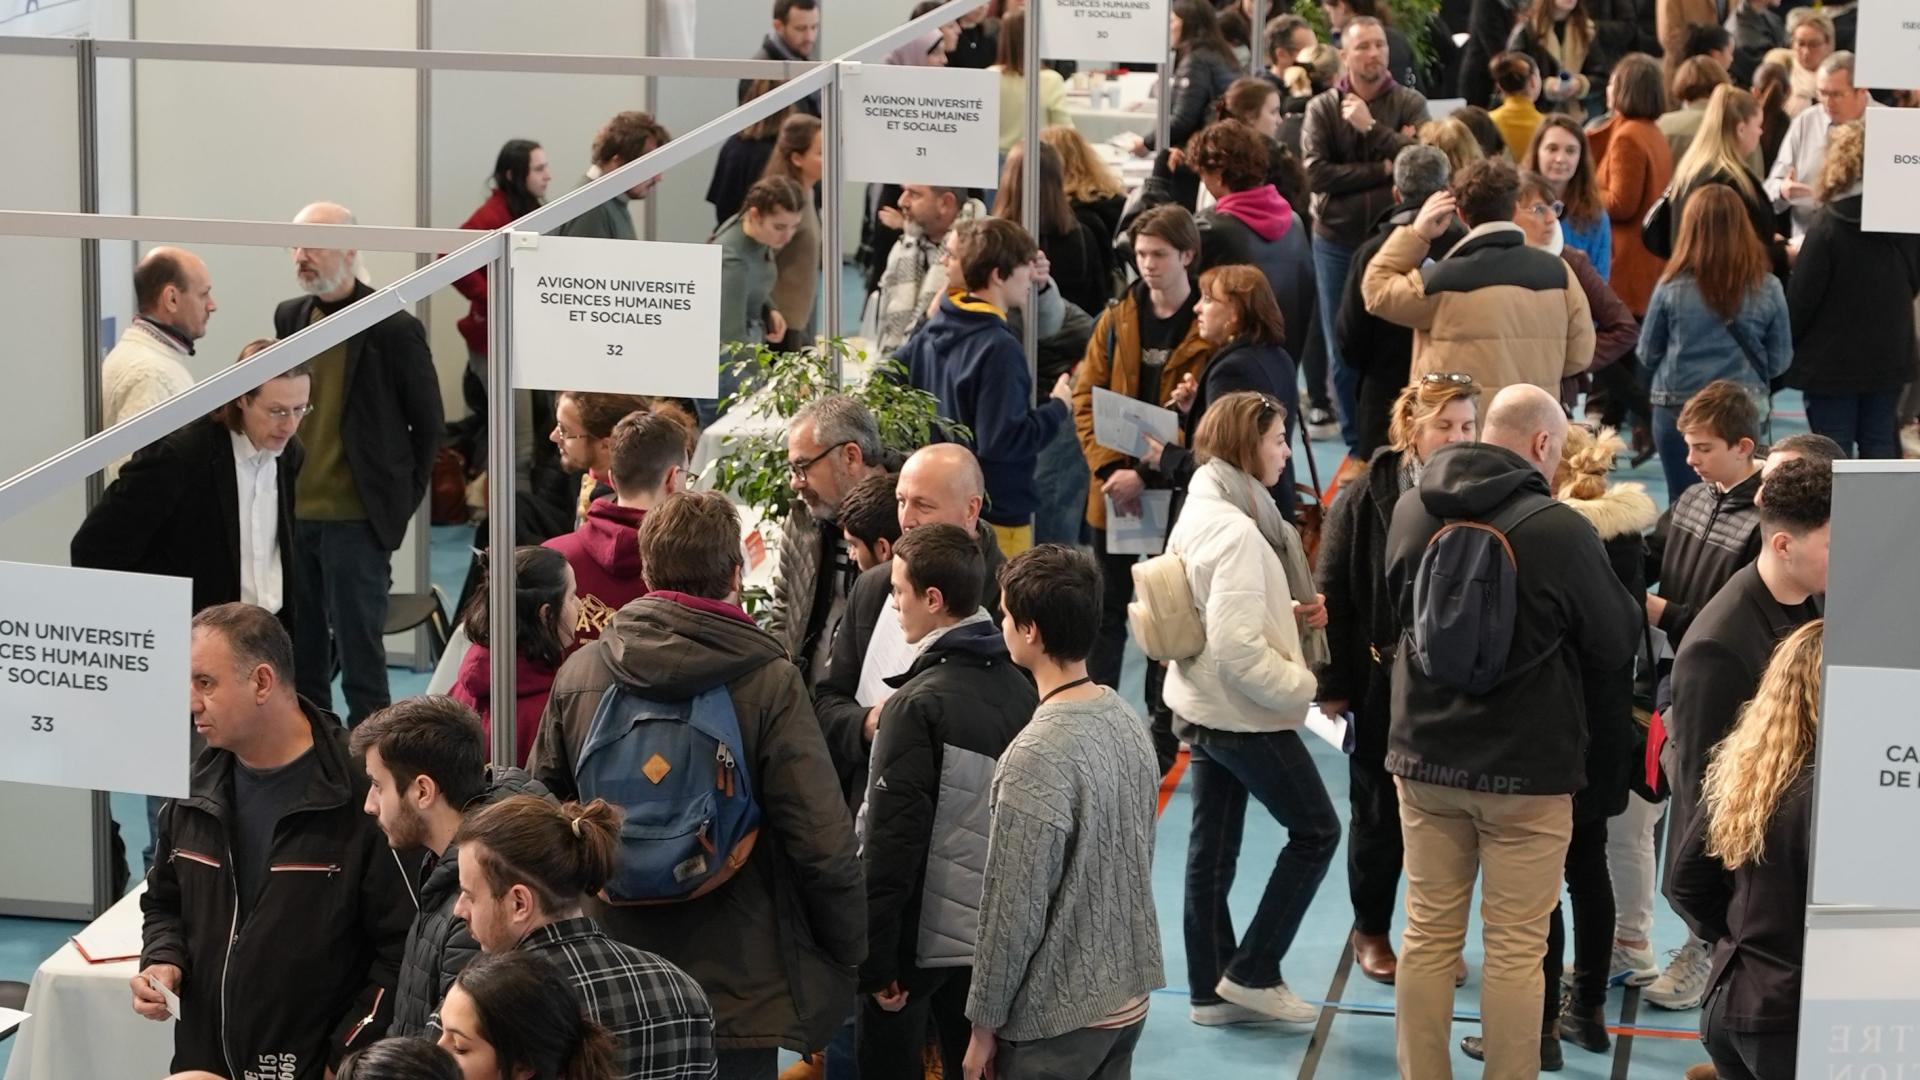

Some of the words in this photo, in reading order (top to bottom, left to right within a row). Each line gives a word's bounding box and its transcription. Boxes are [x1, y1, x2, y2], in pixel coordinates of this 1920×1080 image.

[1057, 0, 1100, 8] SCIENCES
[1102, 0, 1151, 9] HUMAINES
[1074, 9, 1085, 18] ET
[1087, 10, 1132, 19] SOCIALES
[1096, 31, 1109, 39] 30
[862, 94, 916, 106] AVIGNON
[917, 97, 983, 109] UNIVERSITÉ
[864, 107, 919, 118] SCIENCES
[921, 110, 980, 121] HUMAINES
[887, 120, 901, 130] ET
[903, 121, 958, 133] SOCIALES
[915, 147, 927, 156] 31
[1893, 154, 1920, 165] BOS
[537, 276, 607, 290] AVIGNON
[610, 280, 696, 295] UNIVERSITÉ
[540, 292, 611, 307] SCIENCES
[614, 296, 692, 311] HUMAINES
[569, 310, 587, 322] ET
[590, 311, 662, 326] SOCIALES
[606, 344, 624, 356] 32
[35, 623, 156, 650] UNIVERSITÉ
[42, 647, 150, 673] HUMAINES
[8, 667, 109, 692] SOCIALES
[31, 715, 55, 733] 33
[1886, 745, 1920, 763] CA
[1880, 769, 1912, 788] DE
